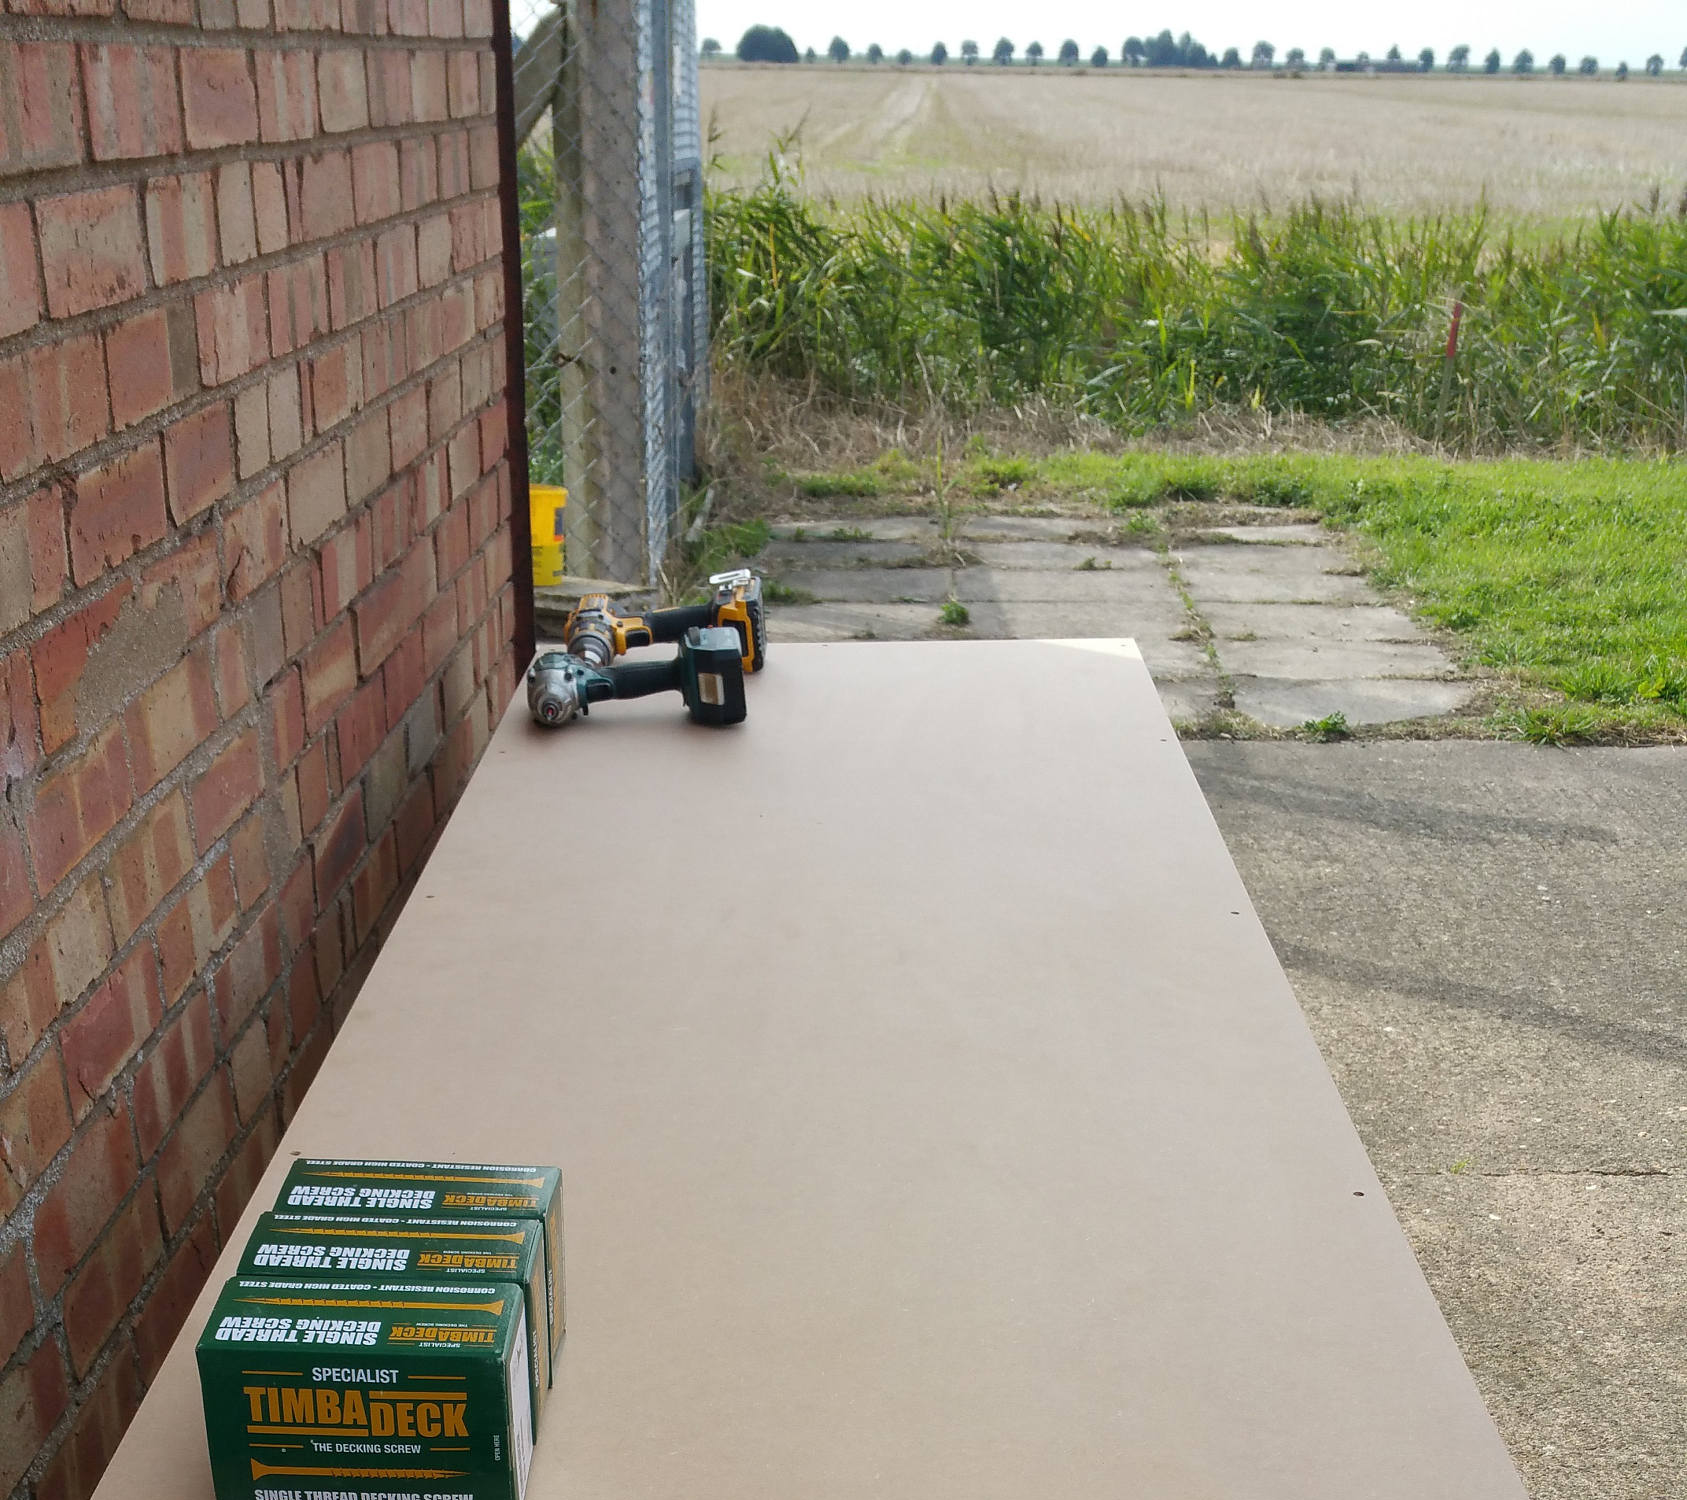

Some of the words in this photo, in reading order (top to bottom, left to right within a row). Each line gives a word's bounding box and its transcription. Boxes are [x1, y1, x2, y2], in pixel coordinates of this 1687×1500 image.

[290, 1185, 356, 1197] SCREW
[359, 1187, 436, 1200] DECKING
[287, 1195, 361, 1208] THREAD
[365, 1197, 433, 1210] SINGLE
[443, 1194, 538, 1207] TIMBADECK
[406, 1218, 459, 1226] RESISTANT
[460, 1219, 518, 1227] CORROSION
[257, 1244, 325, 1255] SCREW
[328, 1246, 411, 1260] DECKING
[253, 1254, 332, 1269] THREAD
[336, 1257, 408, 1272] SINGLE
[418, 1253, 518, 1269] TIMBADECK
[239, 1280, 268, 1288] STEEL
[268, 1281, 303, 1289] GRADE
[304, 1282, 330, 1290] HIGH
[331, 1283, 373, 1291] COATED
[377, 1284, 434, 1293] RESISTANT
[435, 1286, 496, 1294] CORROSION
[219, 1316, 293, 1330] SCREW
[295, 1319, 382, 1334] DECKING
[215, 1328, 298, 1343] THREAD
[302, 1330, 379, 1346] SINGLE
[390, 1326, 496, 1343] TIMBADECK
[312, 1367, 399, 1384] SPECIALIST
[243, 1386, 470, 1438] TIMBADECK
[313, 1442, 333, 1453] THE
[335, 1443, 383, 1454] DECKING
[384, 1444, 421, 1454] SCREW
